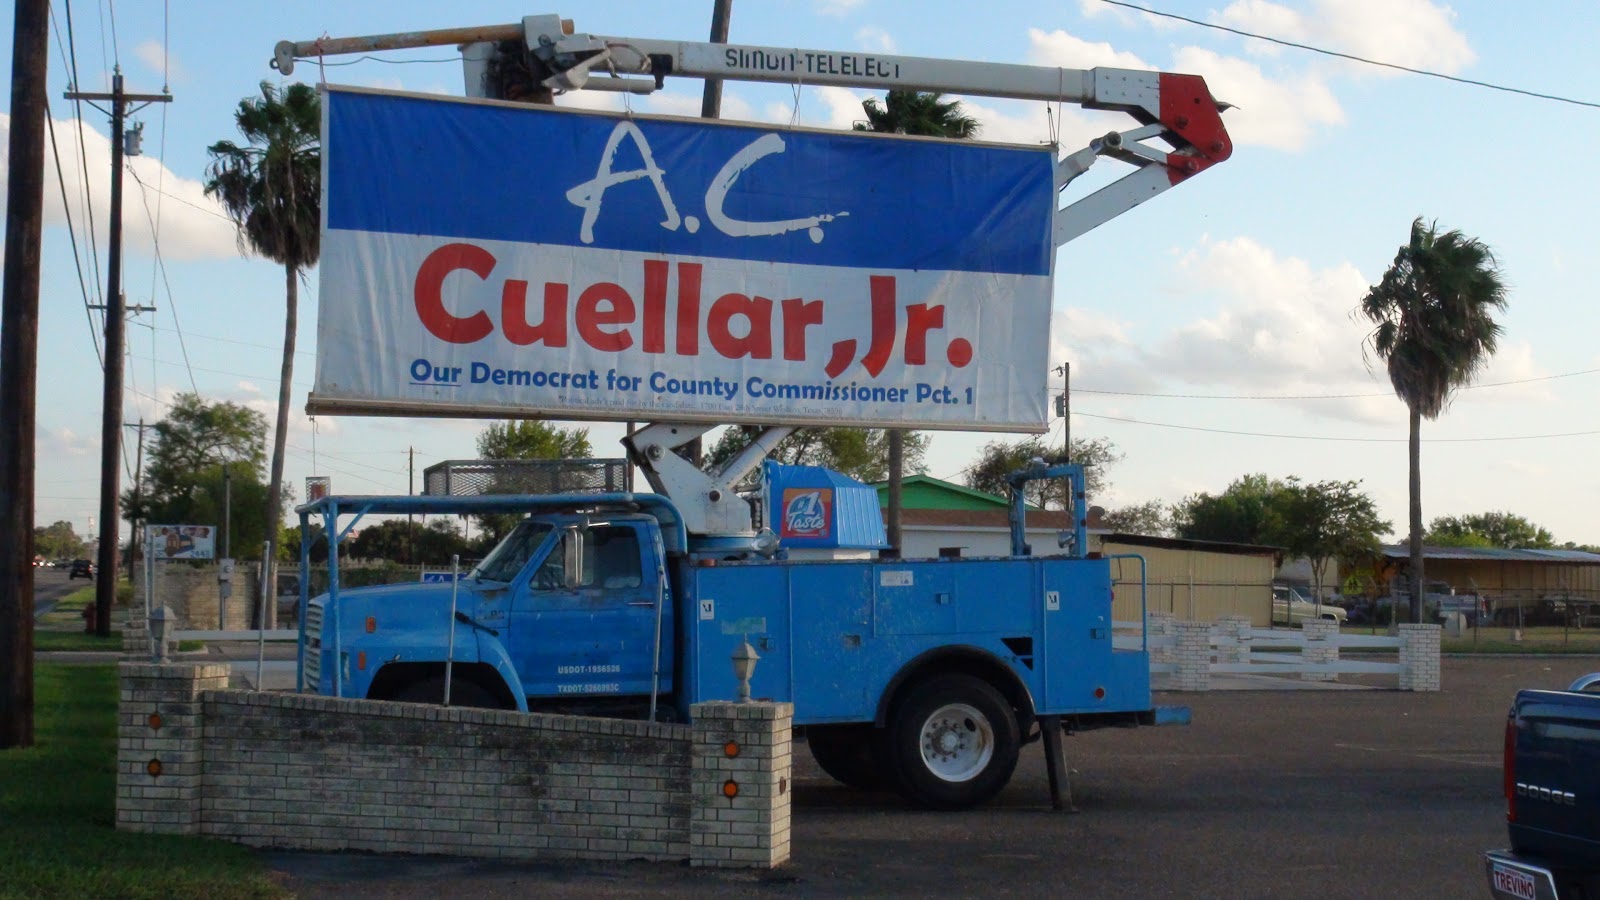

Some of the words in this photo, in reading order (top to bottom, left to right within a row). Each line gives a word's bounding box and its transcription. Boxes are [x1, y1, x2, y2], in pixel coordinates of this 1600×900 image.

[409, 358, 463, 384] Our
[470, 361, 599, 390] Democrat
[606, 368, 643, 392] for
[650, 371, 739, 400] County
[746, 376, 908, 404] Commissioner
[916, 383, 959, 405] Pct.
[964, 387, 973, 405] 1
[786, 510, 826, 532] Taste
[1516, 782, 1576, 805] DODGE
